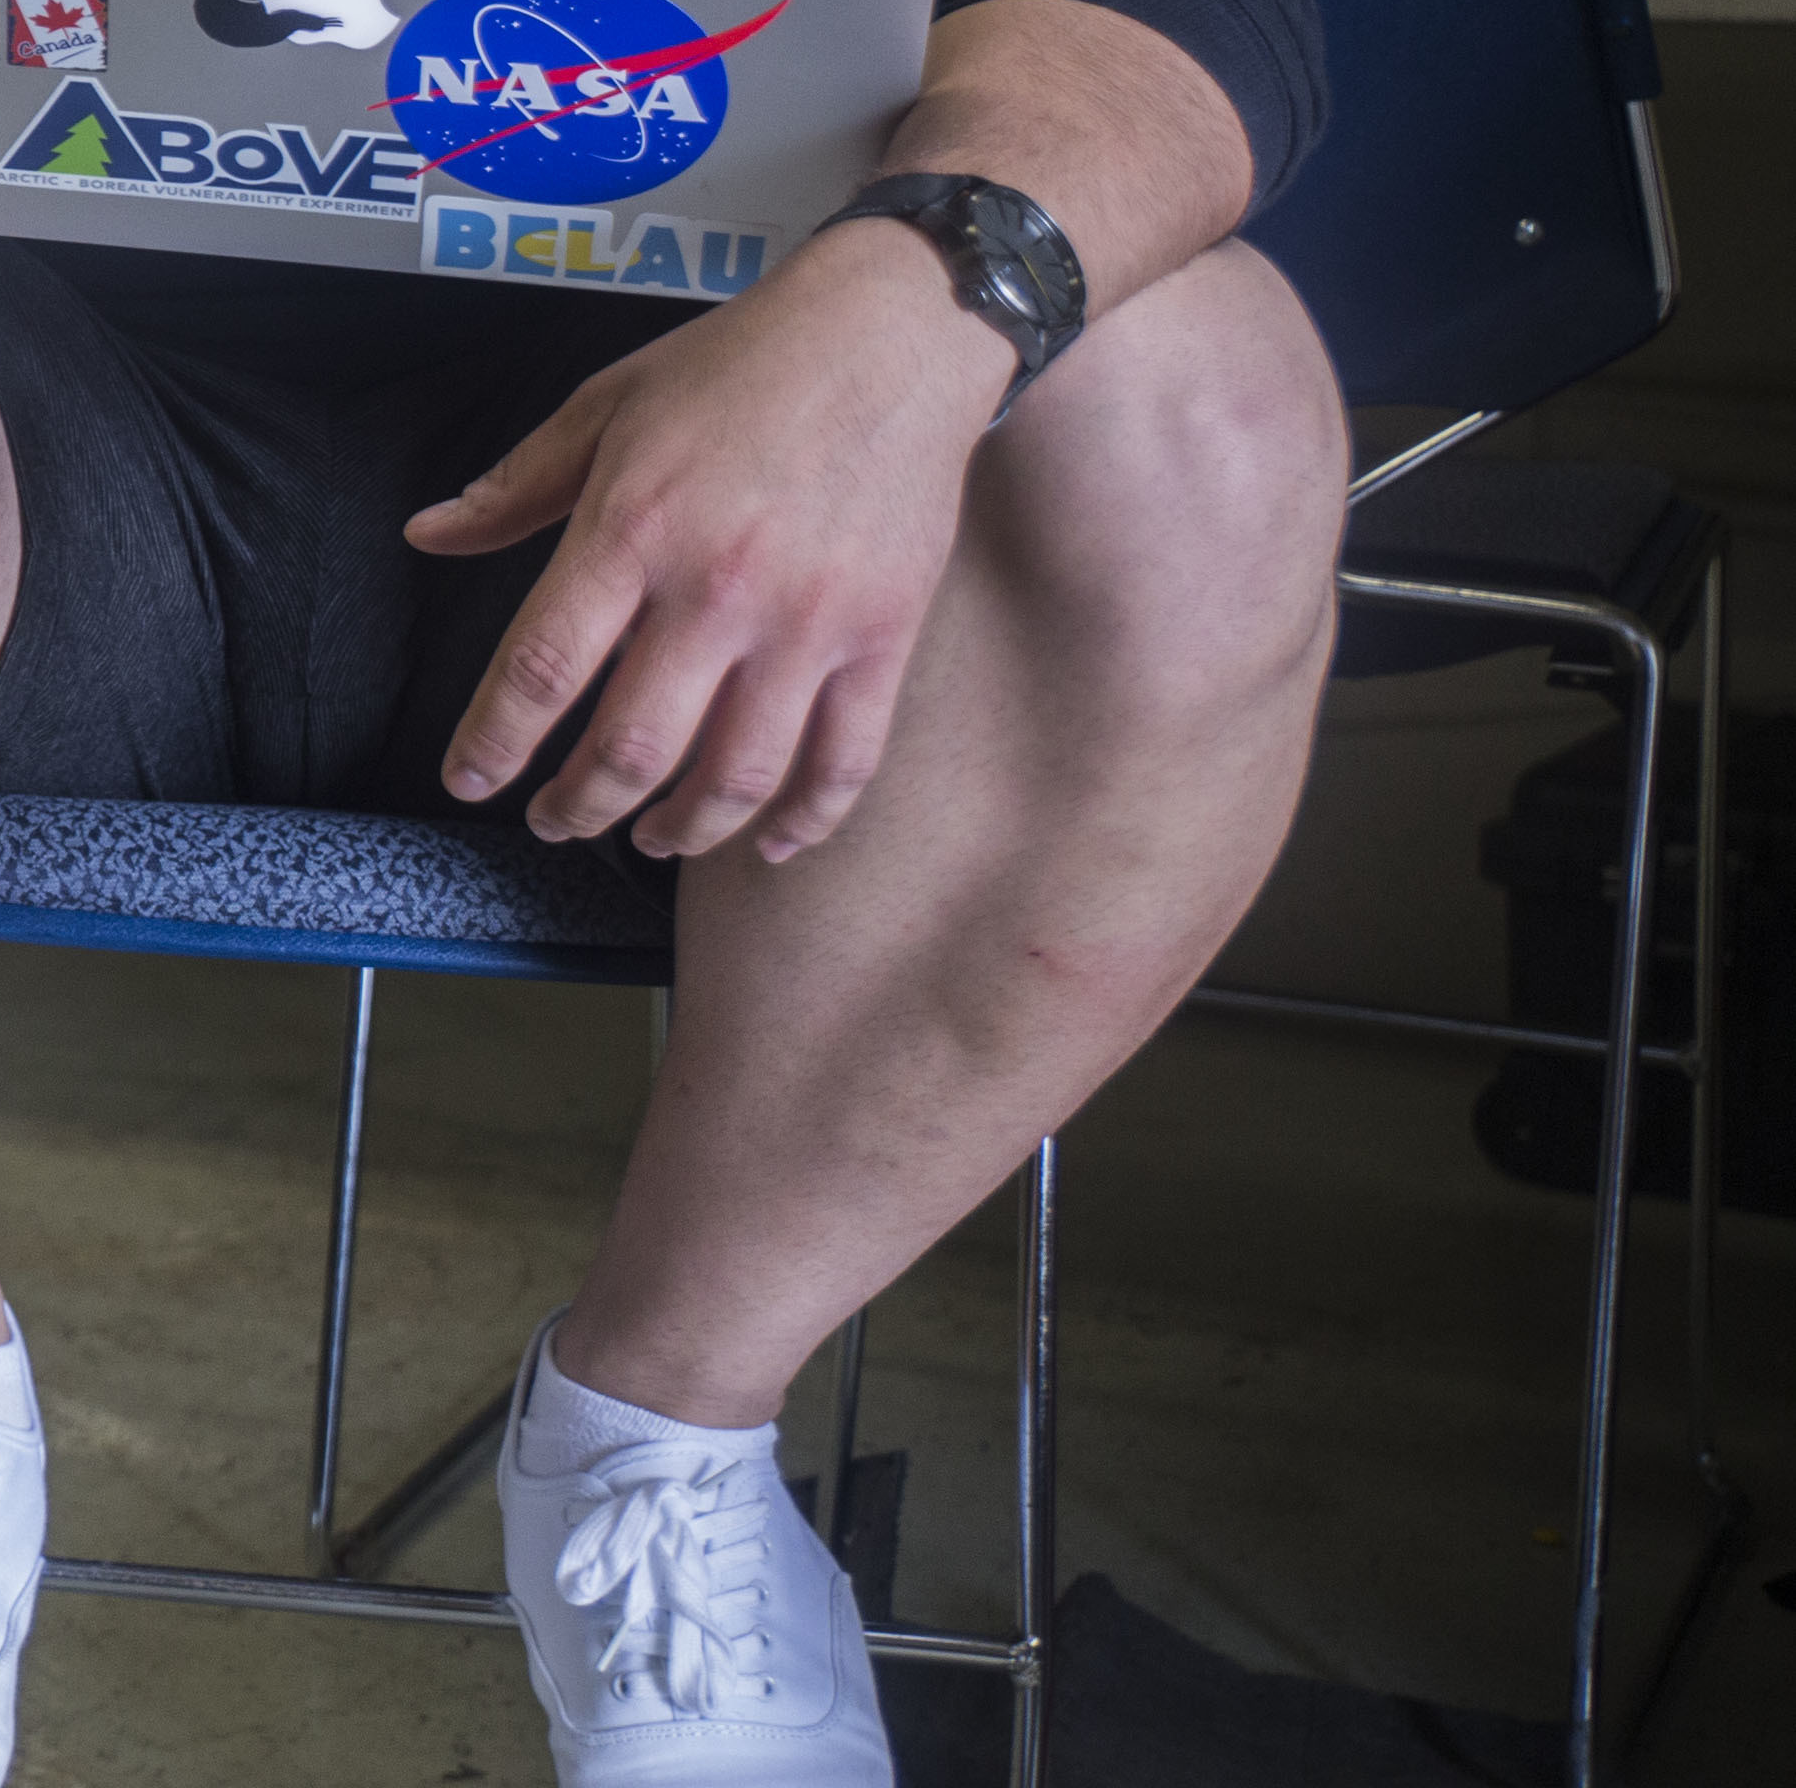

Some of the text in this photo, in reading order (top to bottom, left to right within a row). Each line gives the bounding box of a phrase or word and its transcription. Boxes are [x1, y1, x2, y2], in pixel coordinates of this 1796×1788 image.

[18, 32, 97, 58] Canada
[412, 54, 709, 125] NASA
[79, 178, 149, 196] BOREAL
[154, 184, 296, 207] VULNERABILITY
[299, 198, 415, 218] EXPERIMENT
[433, 206, 767, 291] BELAU
